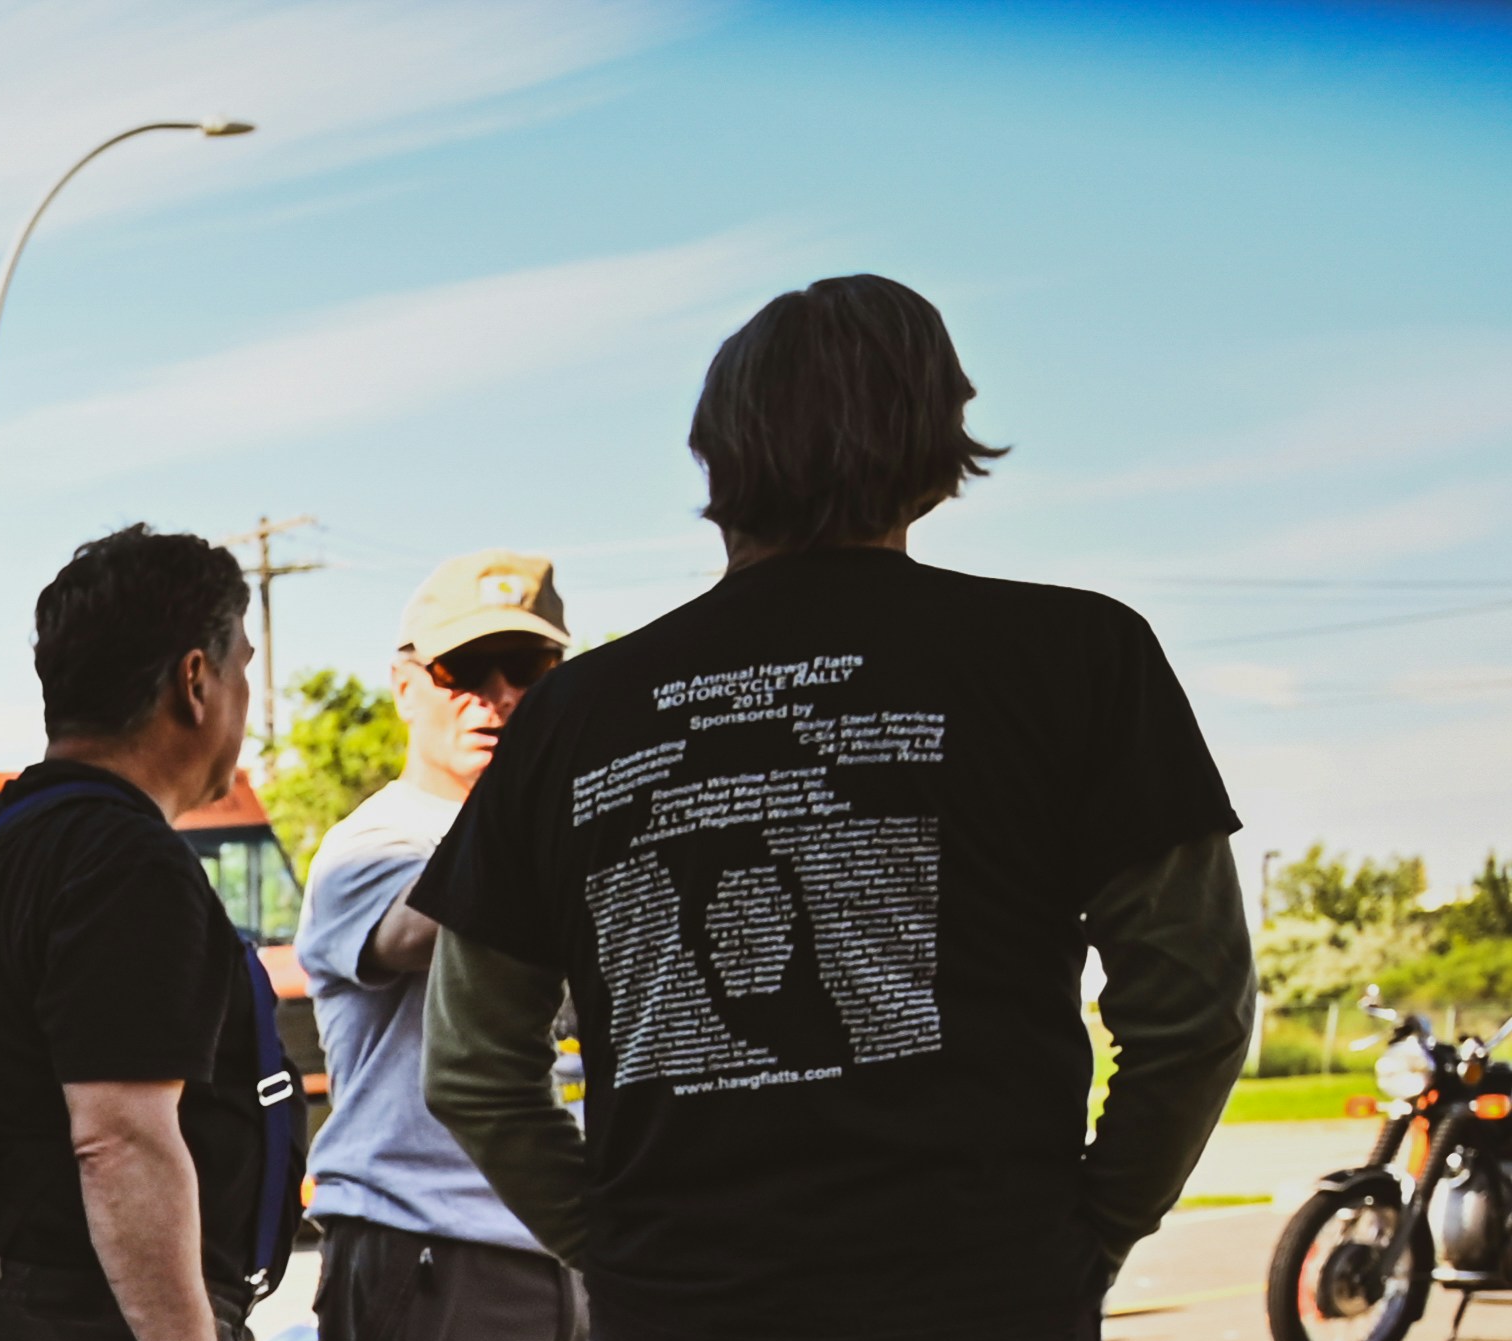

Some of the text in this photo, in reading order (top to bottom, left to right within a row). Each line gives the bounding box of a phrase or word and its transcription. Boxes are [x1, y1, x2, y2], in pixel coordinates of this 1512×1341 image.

[653, 654, 864, 699] 14th Annual Hawg Flatts
[657, 668, 853, 711] MOTORCYCLE RALLY
[732, 693, 774, 709] 2013
[689, 703, 814, 731] Sponsored by
[880, 711, 945, 724] Services
[885, 725, 945, 739] Hauling
[610, 738, 687, 771] Contracting
[897, 751, 944, 762] Waste
[607, 752, 684, 786] Corporation
[651, 766, 827, 801] Remote Wireline Services
[697, 789, 730, 803] Heat
[733, 782, 799, 798] Machines
[672, 812, 680, 823] L
[684, 803, 730, 821] Supply
[700, 810, 764, 829] Regional
[768, 806, 808, 819] Waste
[673, 1066, 843, 1096] www.hawgflatts.com
